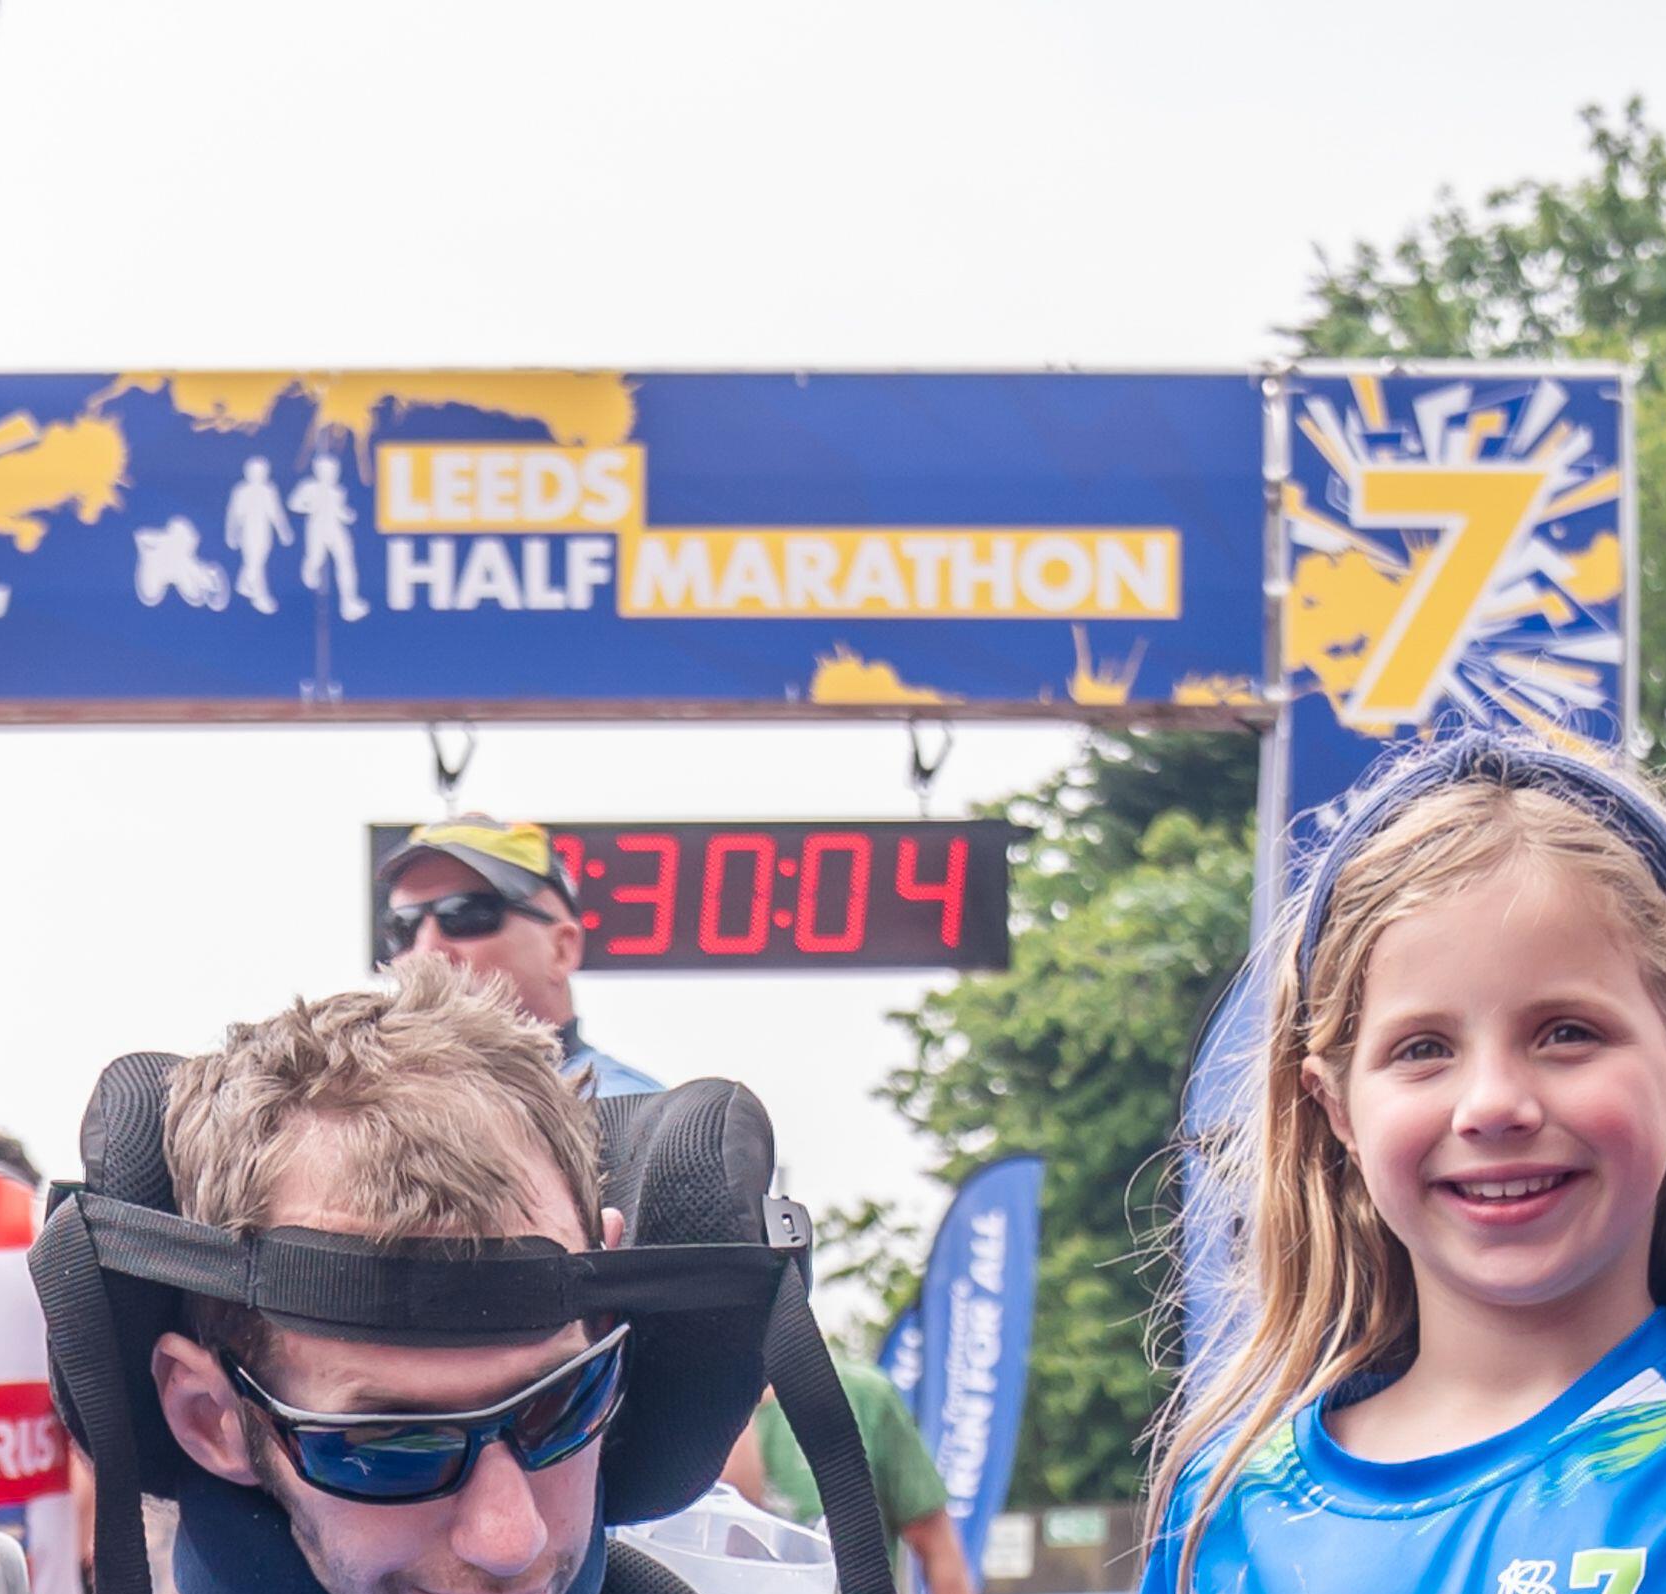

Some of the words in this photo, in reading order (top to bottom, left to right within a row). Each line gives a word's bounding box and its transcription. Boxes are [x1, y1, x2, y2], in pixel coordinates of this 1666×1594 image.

[387, 451, 633, 524] LEEDS
[386, 537, 613, 611] HALF
[631, 535, 1170, 612] MARATHON
[1343, 464, 1558, 724] 7
